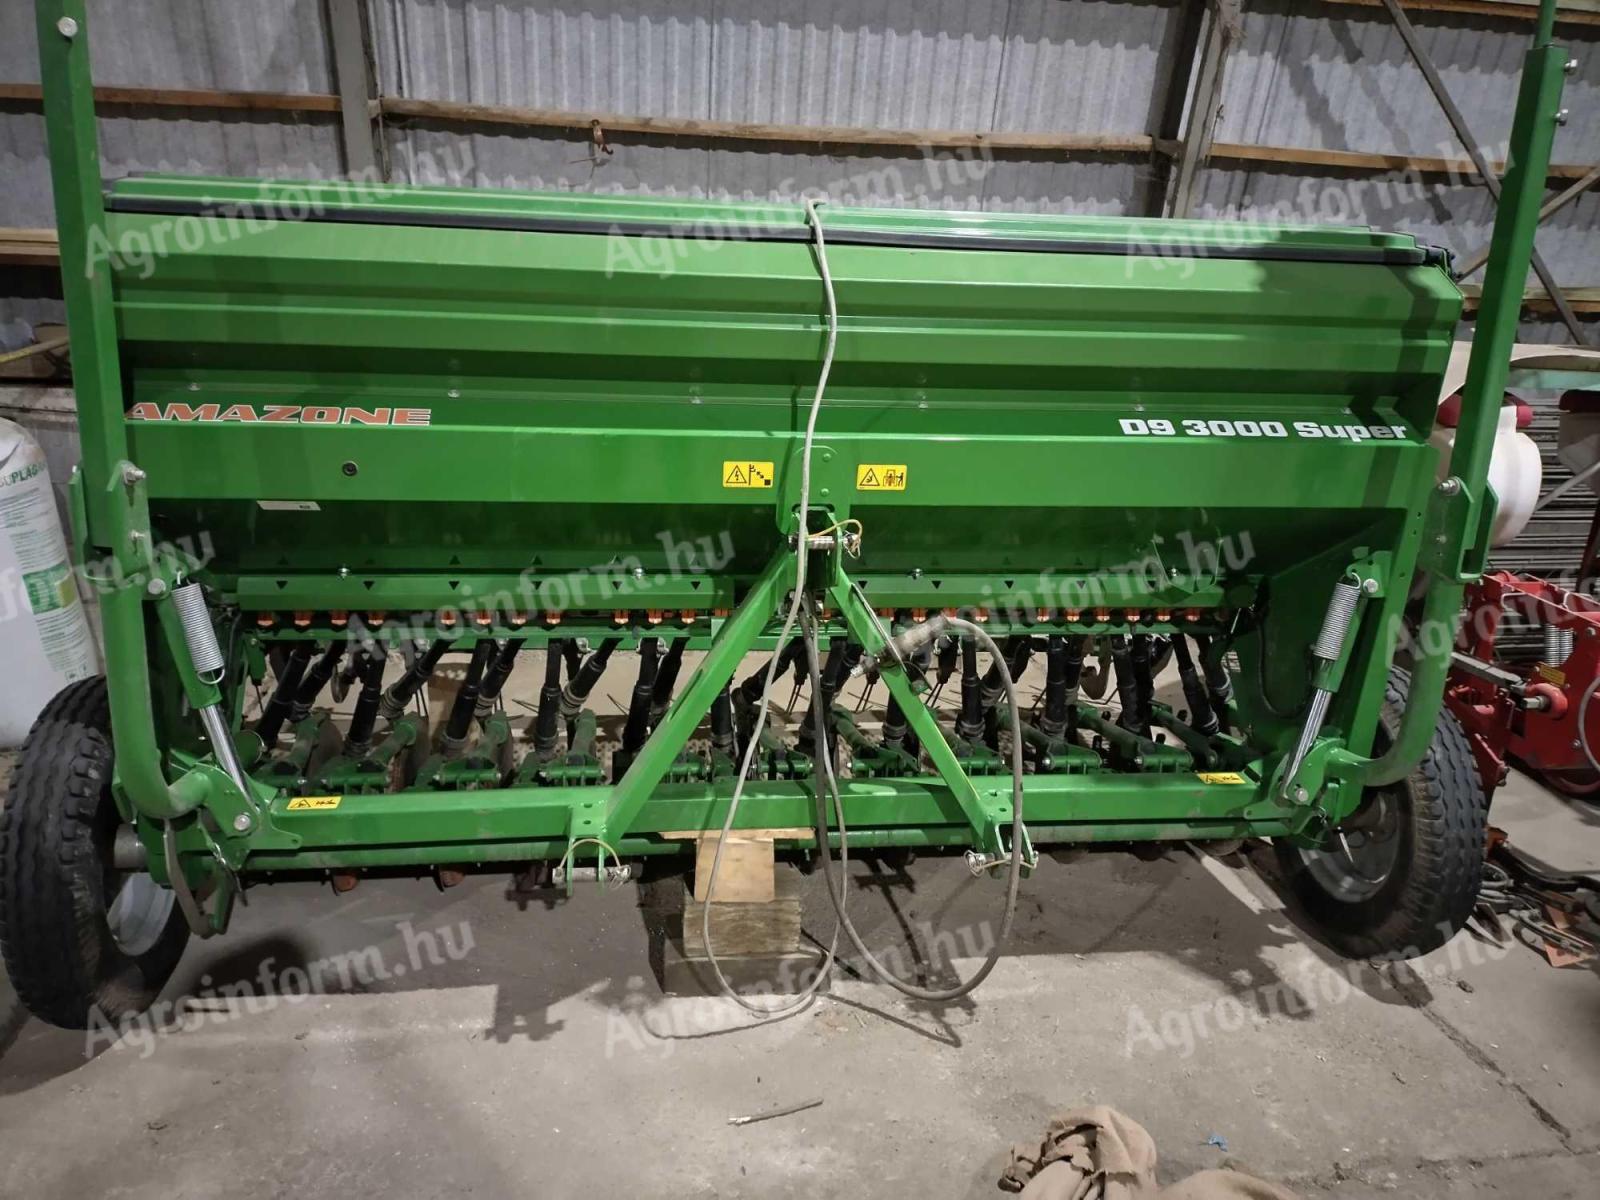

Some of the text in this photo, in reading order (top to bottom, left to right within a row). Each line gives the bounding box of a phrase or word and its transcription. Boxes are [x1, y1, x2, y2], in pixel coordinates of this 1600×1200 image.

[126, 402, 432, 426] AMAZONE
[1118, 418, 1407, 443] D9 3000 Super
